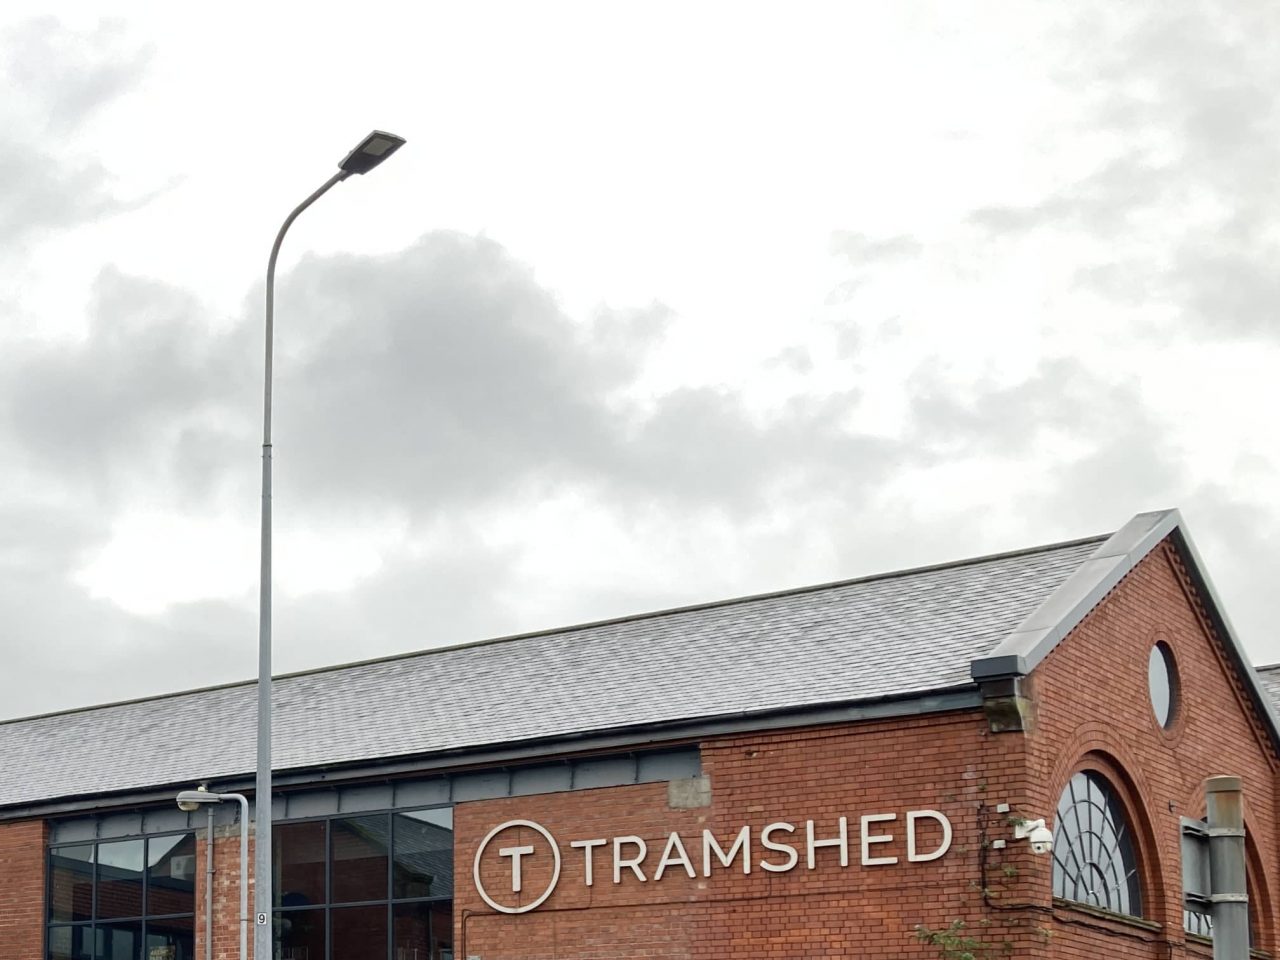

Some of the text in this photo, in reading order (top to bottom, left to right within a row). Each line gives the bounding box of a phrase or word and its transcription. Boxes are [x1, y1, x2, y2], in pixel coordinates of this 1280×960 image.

[498, 808, 954, 893] T TRAMSHED
[258, 913, 266, 924] 9
